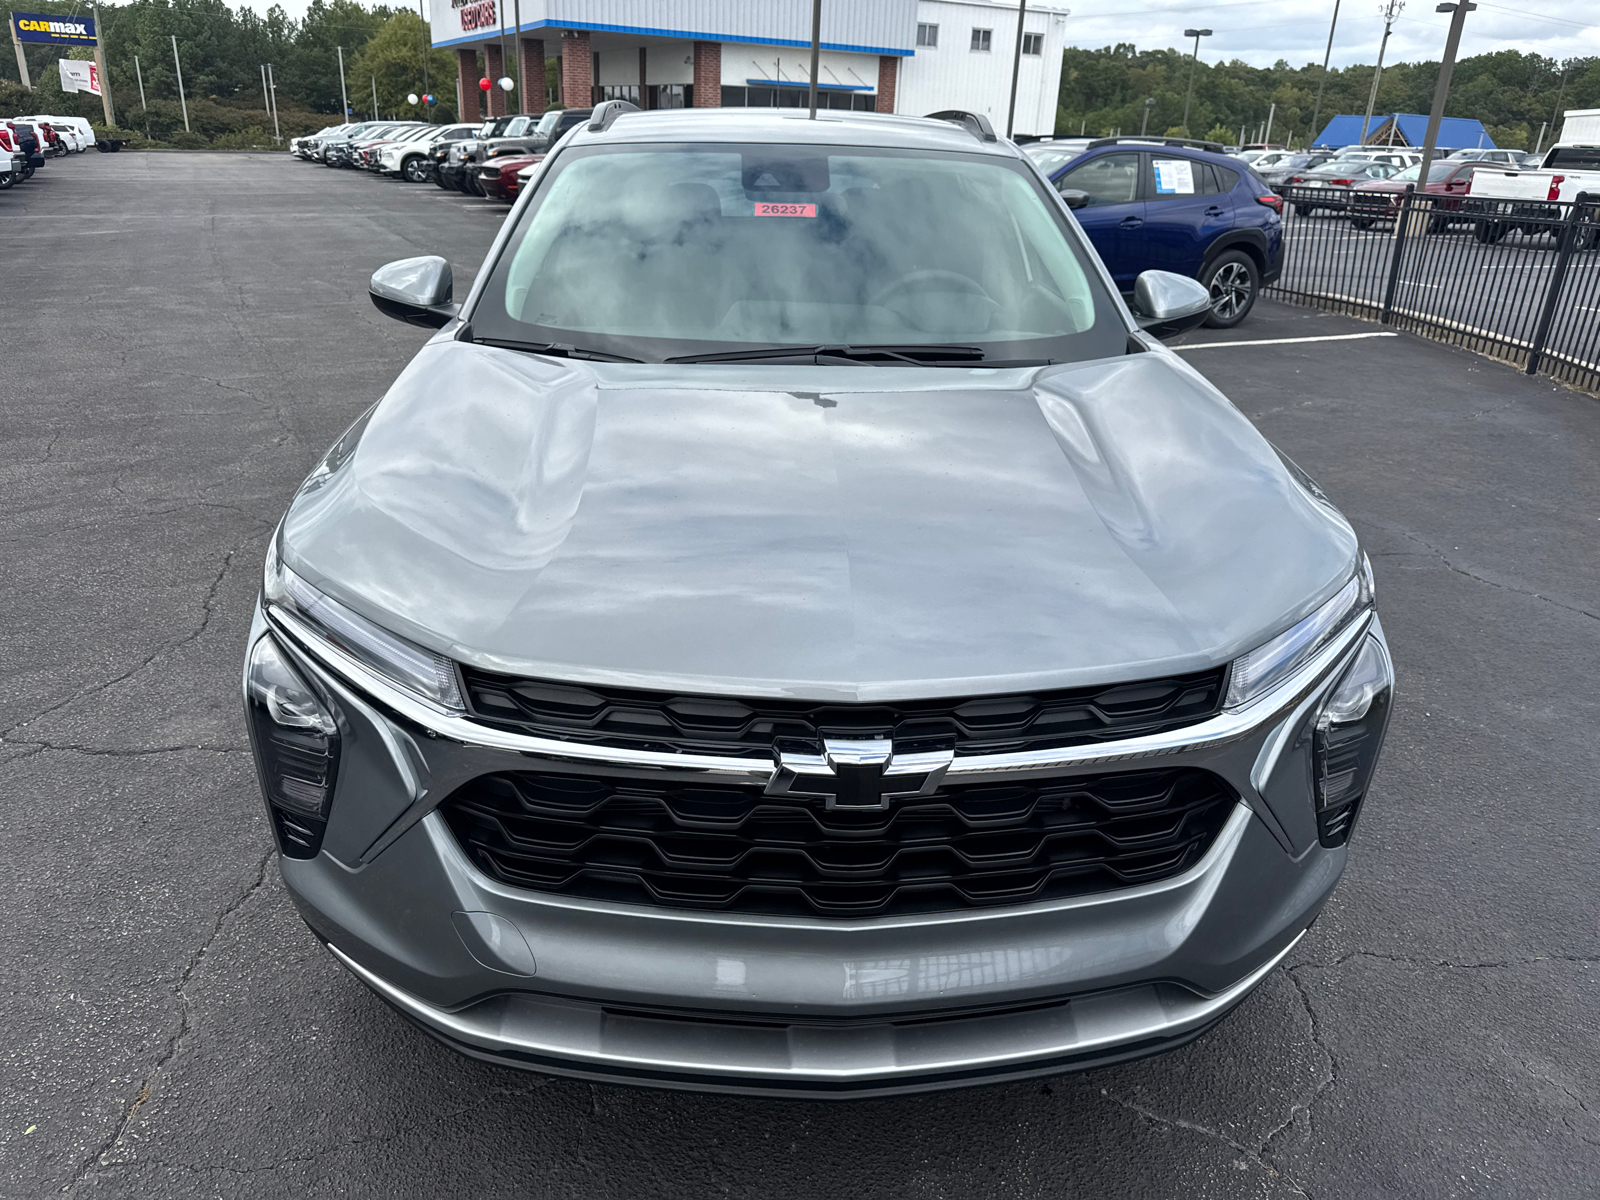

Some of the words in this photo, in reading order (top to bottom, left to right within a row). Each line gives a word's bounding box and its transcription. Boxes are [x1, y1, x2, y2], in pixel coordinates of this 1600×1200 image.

[461, 7, 477, 31] USED
[477, 0, 496, 27] CARS
[761, 204, 807, 215] 26237
